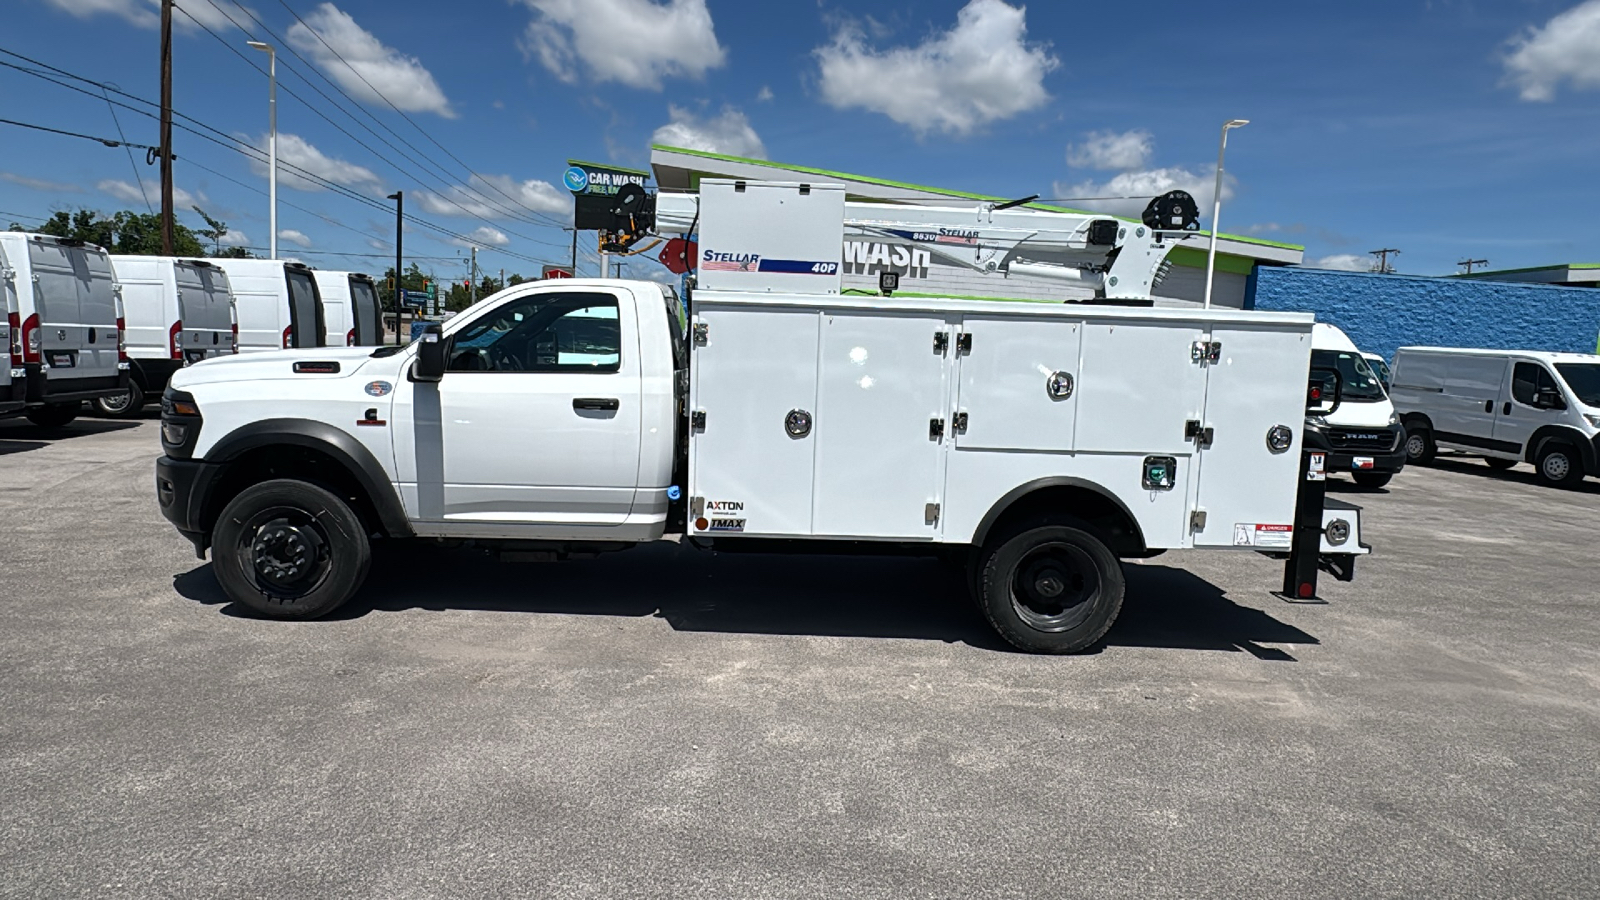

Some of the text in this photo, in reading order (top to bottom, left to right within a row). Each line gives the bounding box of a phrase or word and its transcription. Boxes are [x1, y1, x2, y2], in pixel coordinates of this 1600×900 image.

[589, 172, 643, 187] CAR WASH
[588, 185, 606, 194] FREE
[811, 262, 837, 274] 40P
[706, 501, 744, 511] AXTON
[710, 519, 744, 528] TMAX
